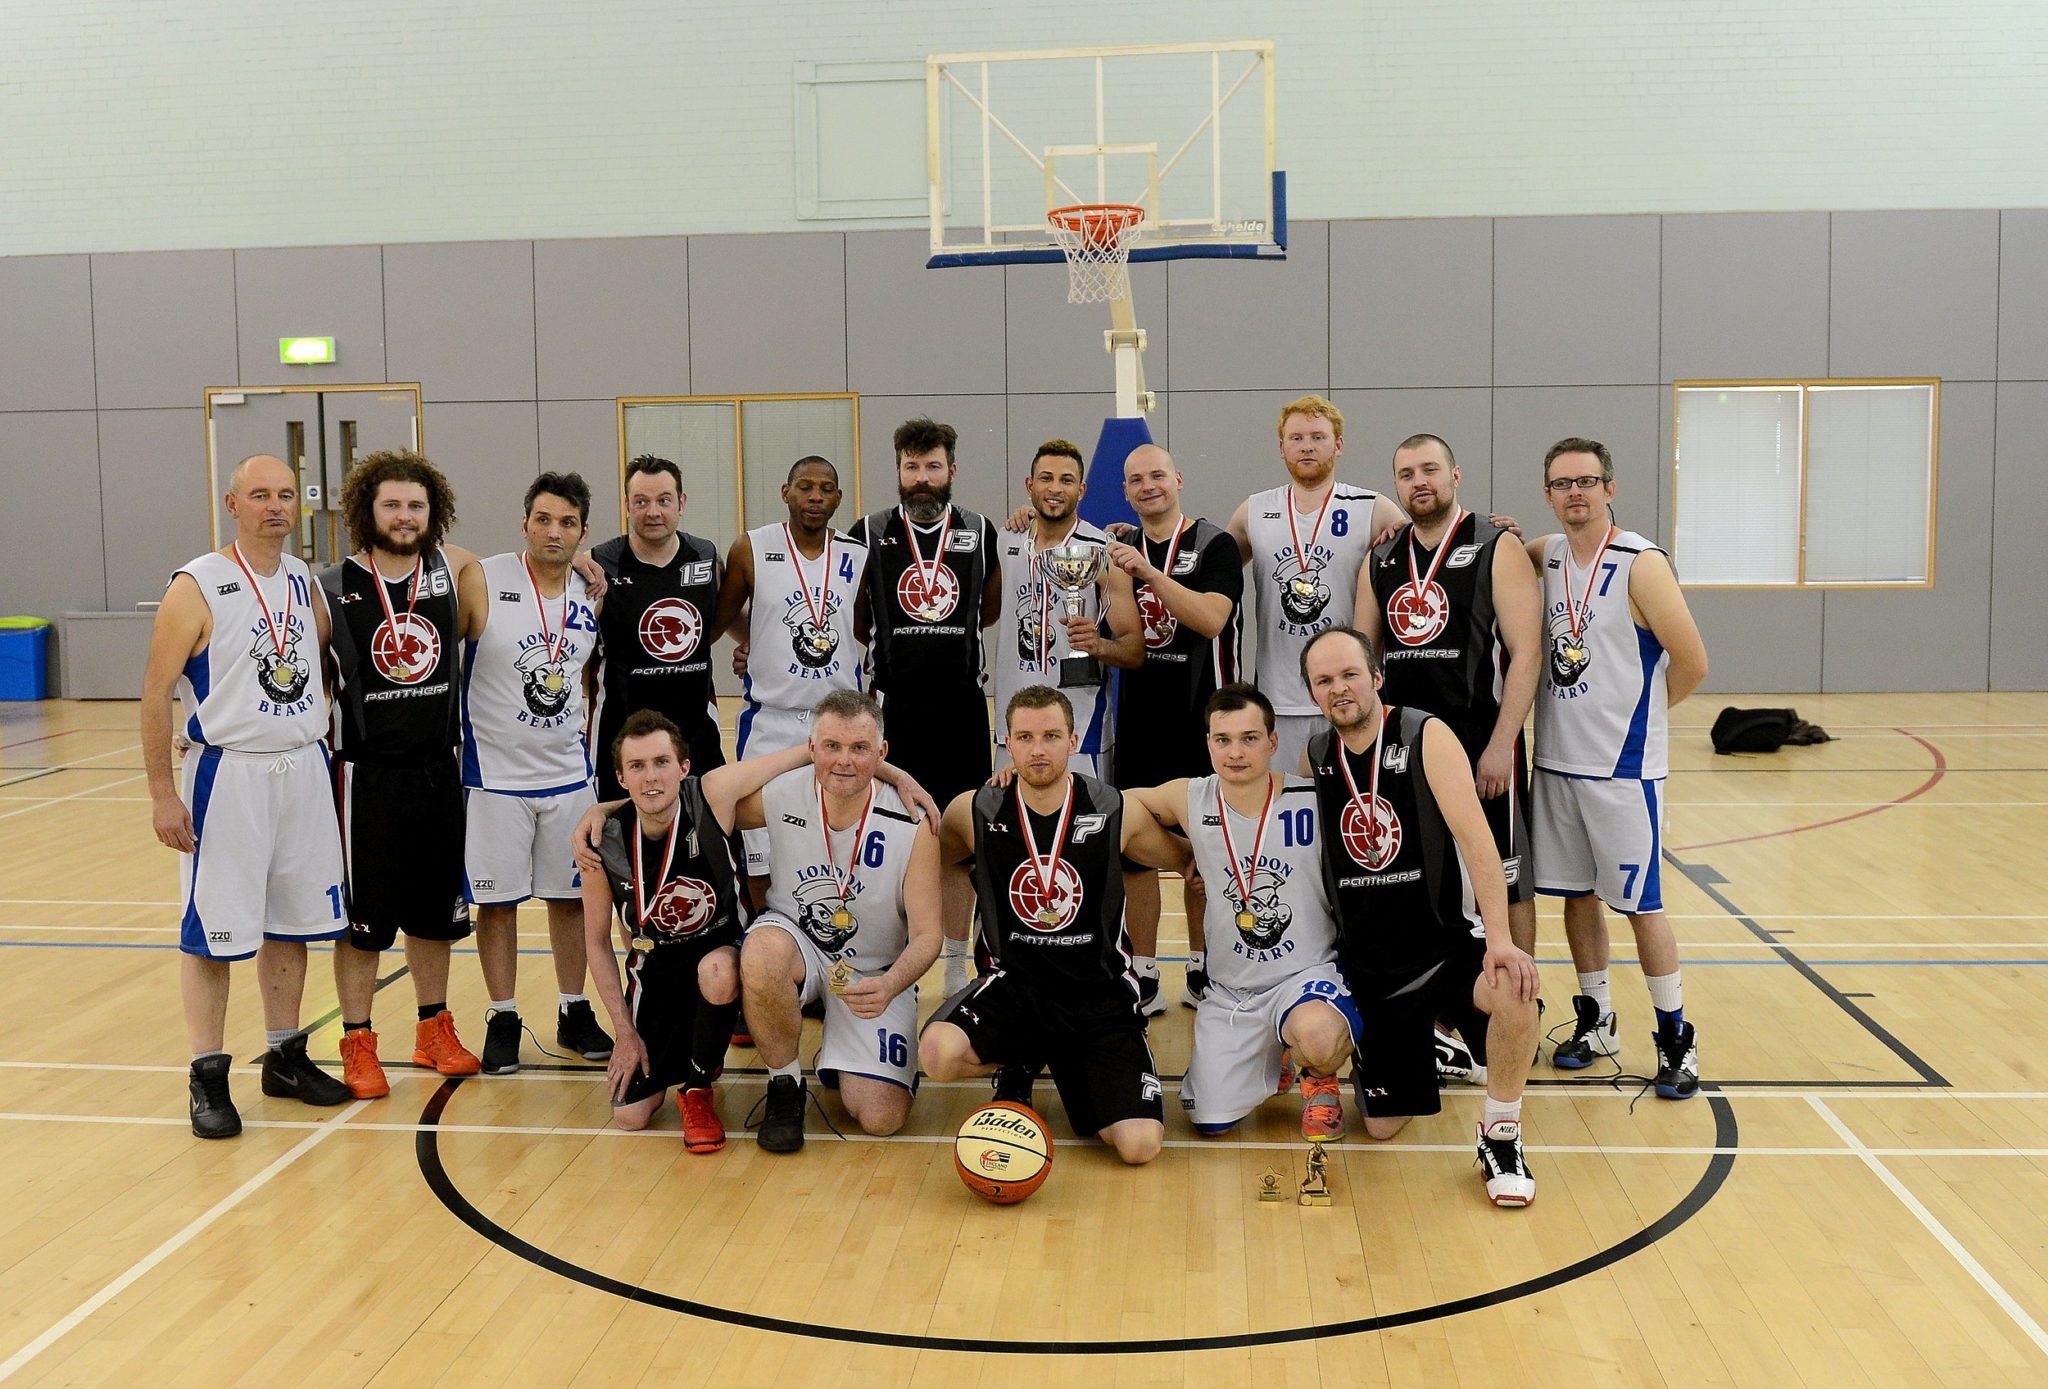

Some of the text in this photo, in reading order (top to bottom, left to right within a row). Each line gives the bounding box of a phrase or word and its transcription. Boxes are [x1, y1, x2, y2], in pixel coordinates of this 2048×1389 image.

[1331, 509, 1348, 537] 8
[943, 529, 980, 552] 13
[839, 553, 854, 583] 4
[1171, 550, 1199, 575] 3
[1446, 543, 1483, 568] 6
[407, 566, 449, 601] 26
[680, 560, 713, 587] 15
[1599, 563, 1618, 596] 7
[287, 573, 310, 608] 11
[785, 586, 843, 607] LODON
[1016, 582, 1060, 604] LODN
[251, 611, 305, 637] LODON
[565, 600, 599, 633] 23
[1549, 599, 1596, 623] LODON
[1278, 617, 1332, 637] BEARD
[1146, 651, 1188, 662] THERS
[788, 660, 840, 680] BEARD
[1547, 679, 1588, 700] BEARD
[258, 693, 315, 718] BEARD
[516, 708, 573, 729] BEARD
[1382, 744, 1410, 773] 4
[1072, 814, 1107, 843] 7
[1278, 808, 1314, 847] 10
[685, 827, 700, 859] 1
[797, 864, 866, 895] LONDON
[1223, 855, 1294, 878] LNDON
[1619, 864, 1640, 899] 7
[325, 881, 345, 920] 1
[1233, 940, 1295, 962] BEARD
[877, 1028, 908, 1068] 16
[1499, 1125, 1516, 1134] NIKE
